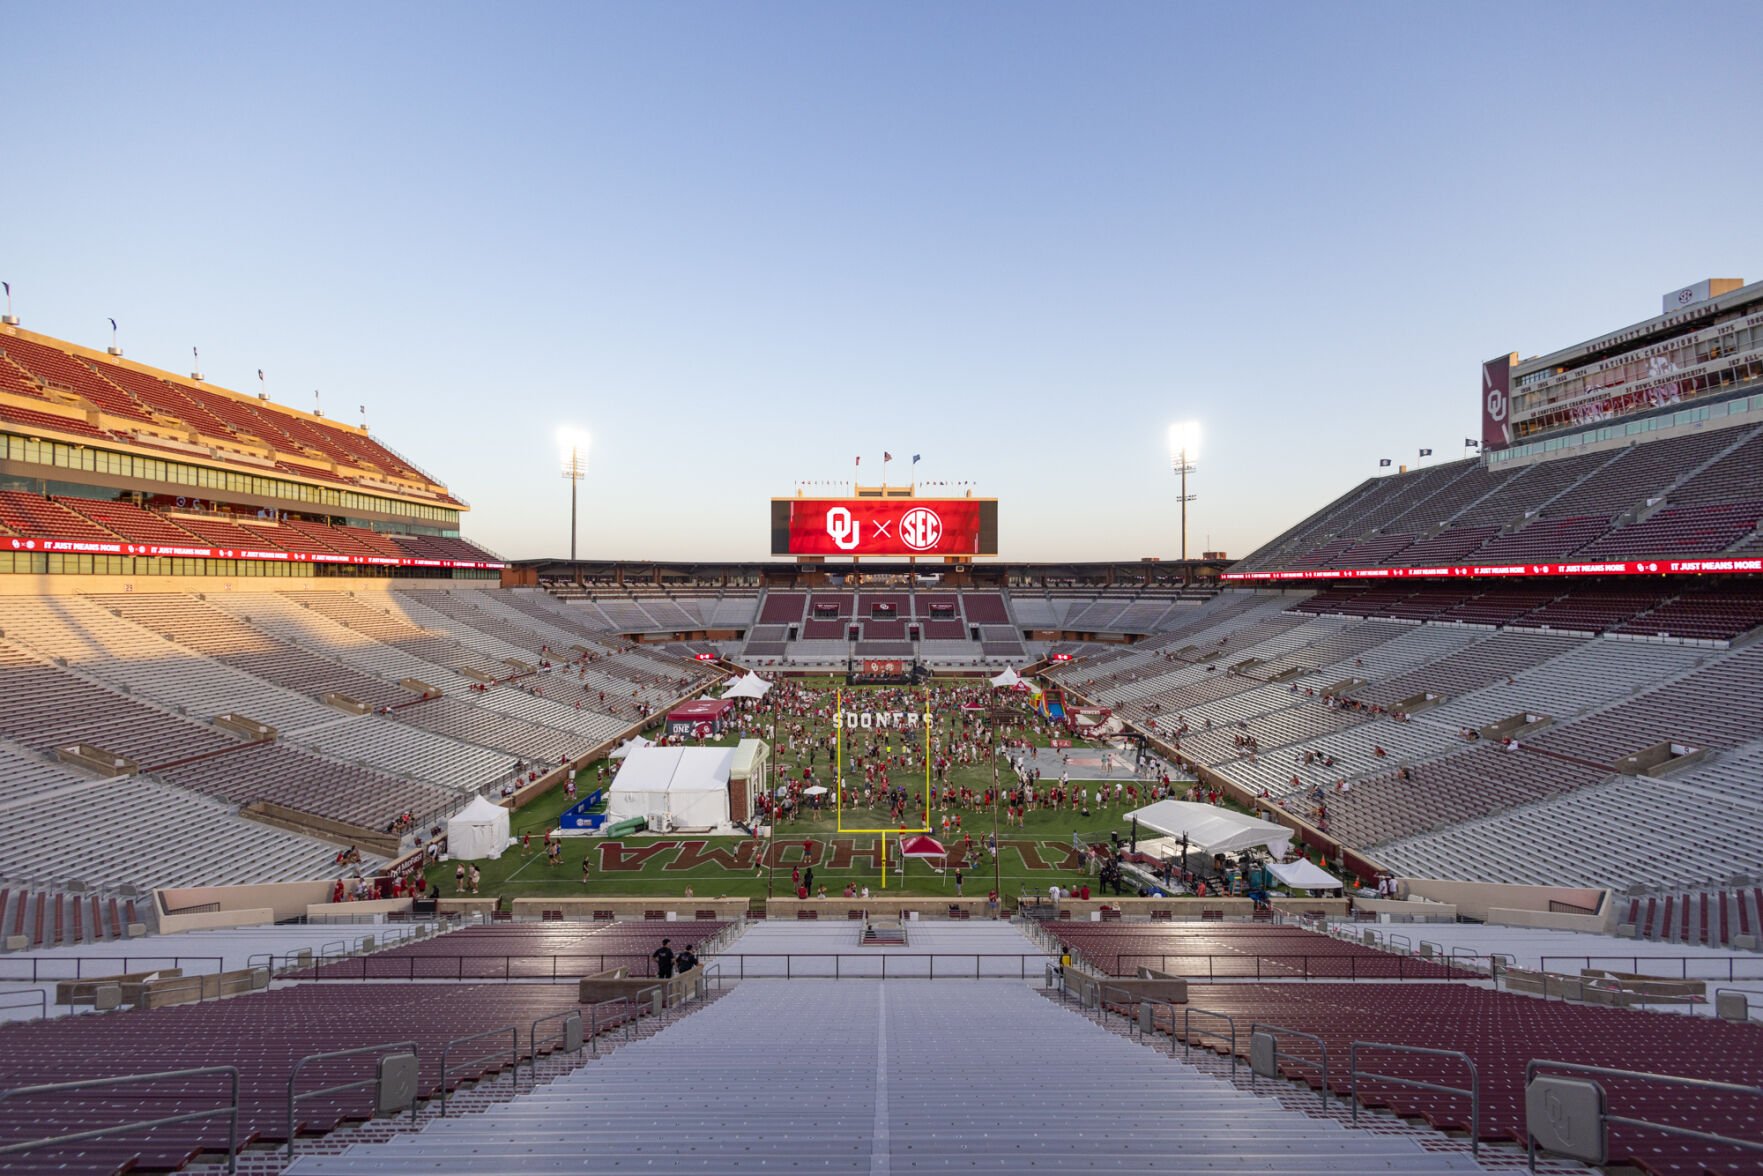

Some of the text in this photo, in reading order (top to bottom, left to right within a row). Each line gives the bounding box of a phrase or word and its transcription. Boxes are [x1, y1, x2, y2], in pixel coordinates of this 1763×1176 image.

[1585, 303, 1719, 352] UNIVERSITY OF OKLAHOMA
[1599, 353, 1640, 370] NATIONAL
[1645, 335, 1698, 357] CHAMPIONS
[1653, 367, 1707, 387] CHAMPIONSHIPS
[1487, 389, 1507, 421] OU
[827, 507, 860, 550] OU
[903, 510, 938, 547] SEC
[73, 542, 99, 551] MEANS
[1671, 560, 1761, 571] IT JUST MEANS MORE
[673, 723, 690, 733] ONE
